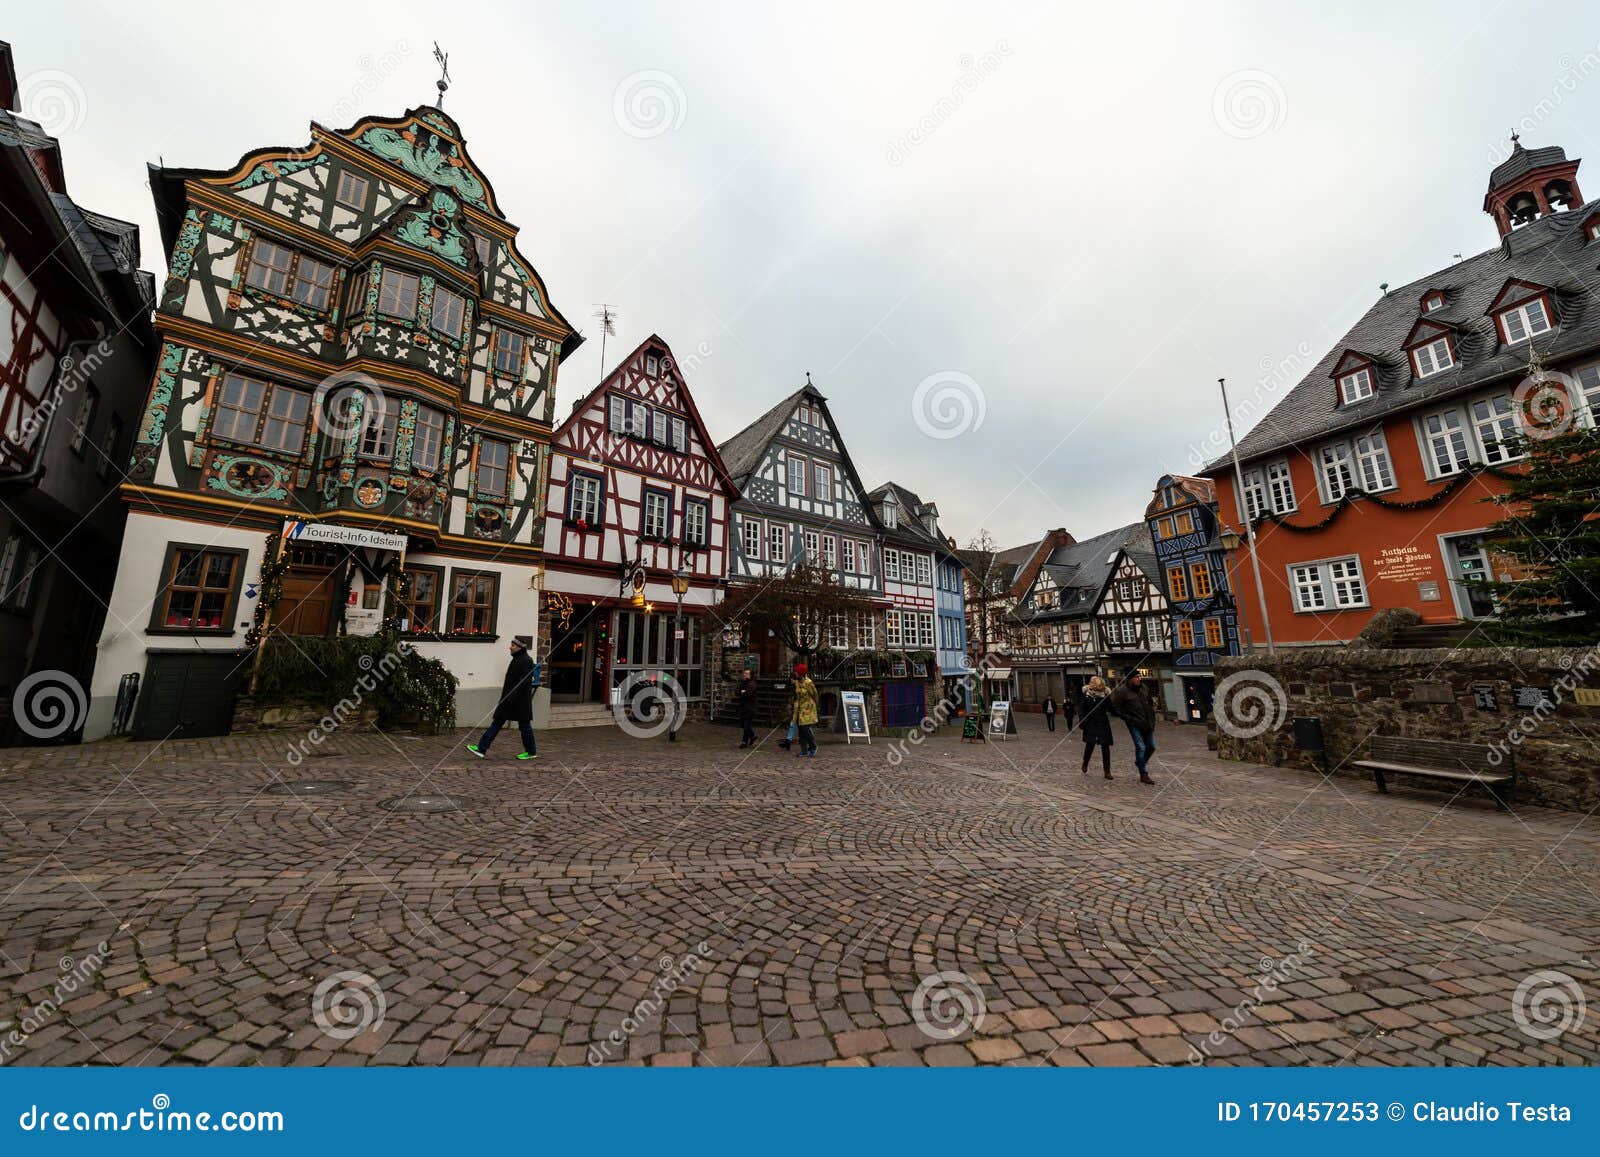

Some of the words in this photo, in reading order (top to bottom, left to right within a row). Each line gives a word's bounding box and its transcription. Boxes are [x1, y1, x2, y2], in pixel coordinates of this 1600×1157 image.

[305, 527, 368, 544] Tourist-Info
[370, 535, 404, 548] Idstein
[1381, 546, 1418, 557] Rathaus
